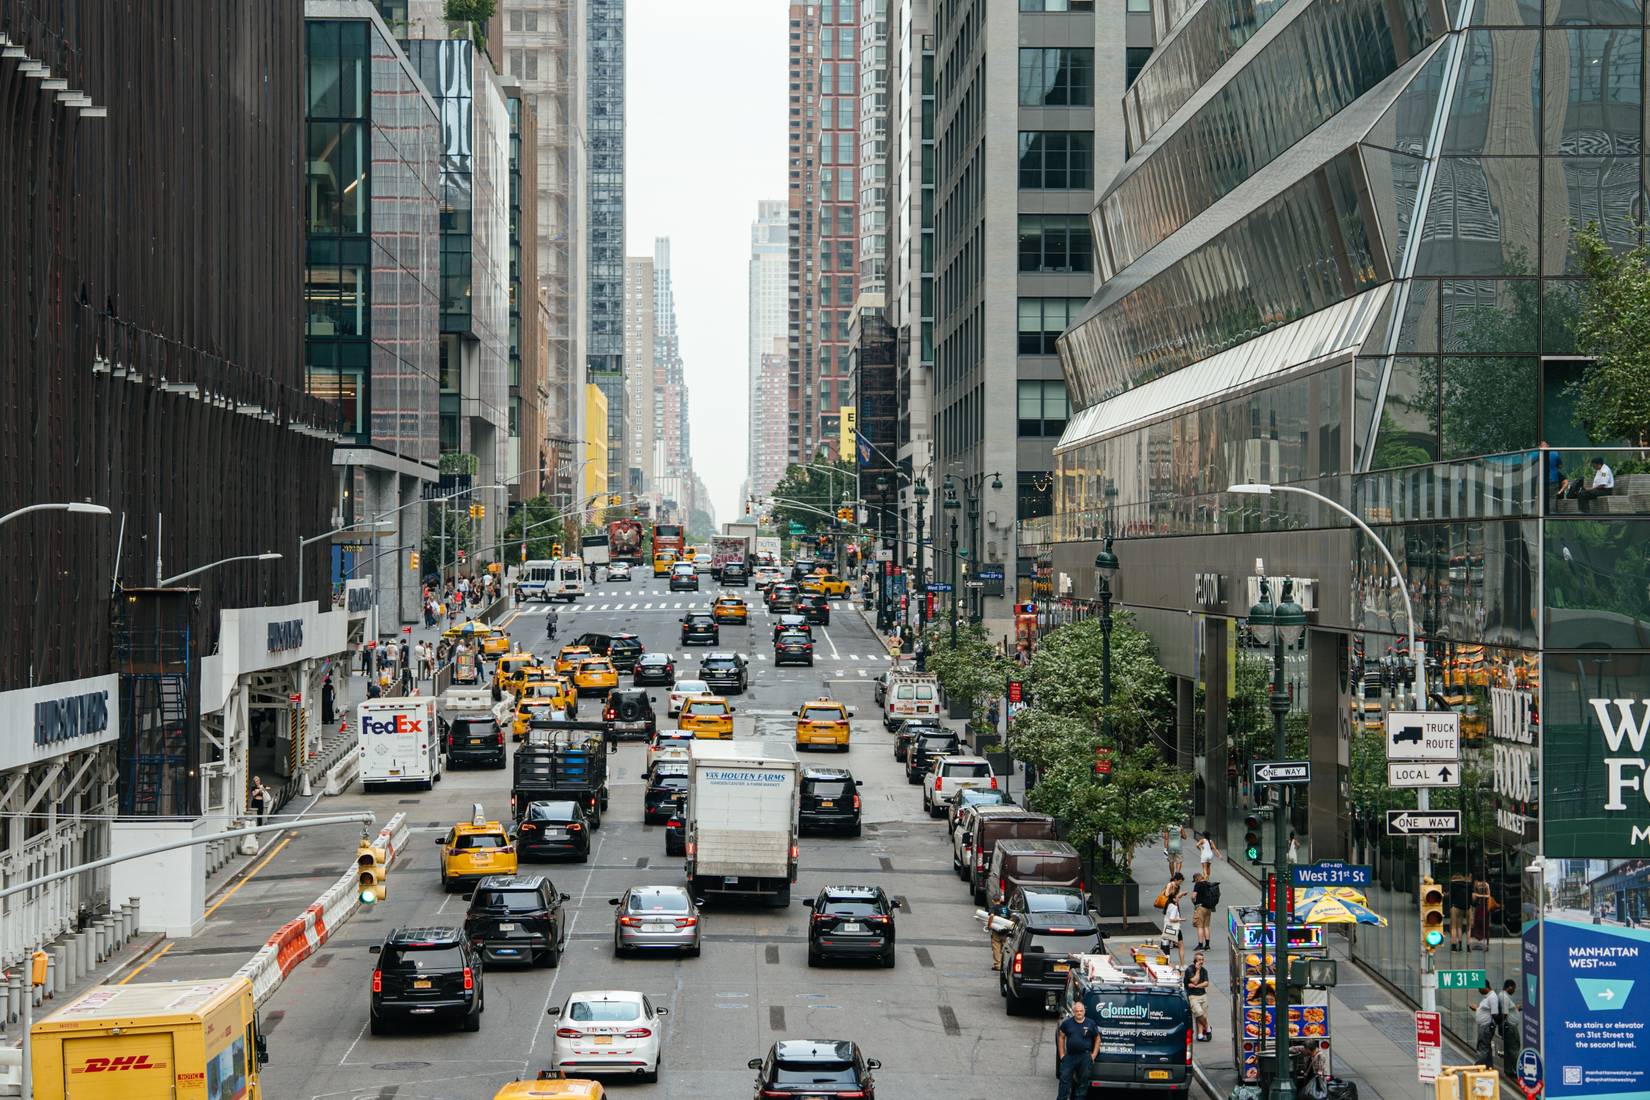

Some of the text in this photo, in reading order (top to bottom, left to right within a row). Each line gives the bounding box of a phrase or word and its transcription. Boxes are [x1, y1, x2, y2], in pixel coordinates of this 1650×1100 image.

[1491, 686, 1533, 745] WHOLE
[362, 714, 422, 735] FedEx
[1426, 723, 1455, 733] TRUCK
[1426, 739, 1455, 749] ROUTE
[720, 772, 756, 781] HOUTEN
[757, 773, 786, 782] FARMS
[1262, 768, 1302, 777] ONE WAY
[1395, 770, 1431, 780] LOCAL
[1493, 743, 1532, 803] FOODS
[1604, 758, 1650, 811] F
[1398, 818, 1450, 828] ONE WAY
[1497, 808, 1526, 836] MARKET
[1298, 870, 1365, 882] West 31st St
[1569, 947, 1639, 957] MANHATTAN
[1569, 958, 1598, 968] WEST
[1443, 972, 1479, 986] W 31 St
[1565, 1021, 1582, 1029] Take
[1584, 1021, 1604, 1029] stairs
[1614, 1021, 1644, 1029] elevator
[1101, 1029, 1168, 1037] Emergency Service
[1587, 1031, 1601, 1039] 31st
[1602, 1031, 1624, 1039] Street
[84, 1055, 154, 1073] DHL
